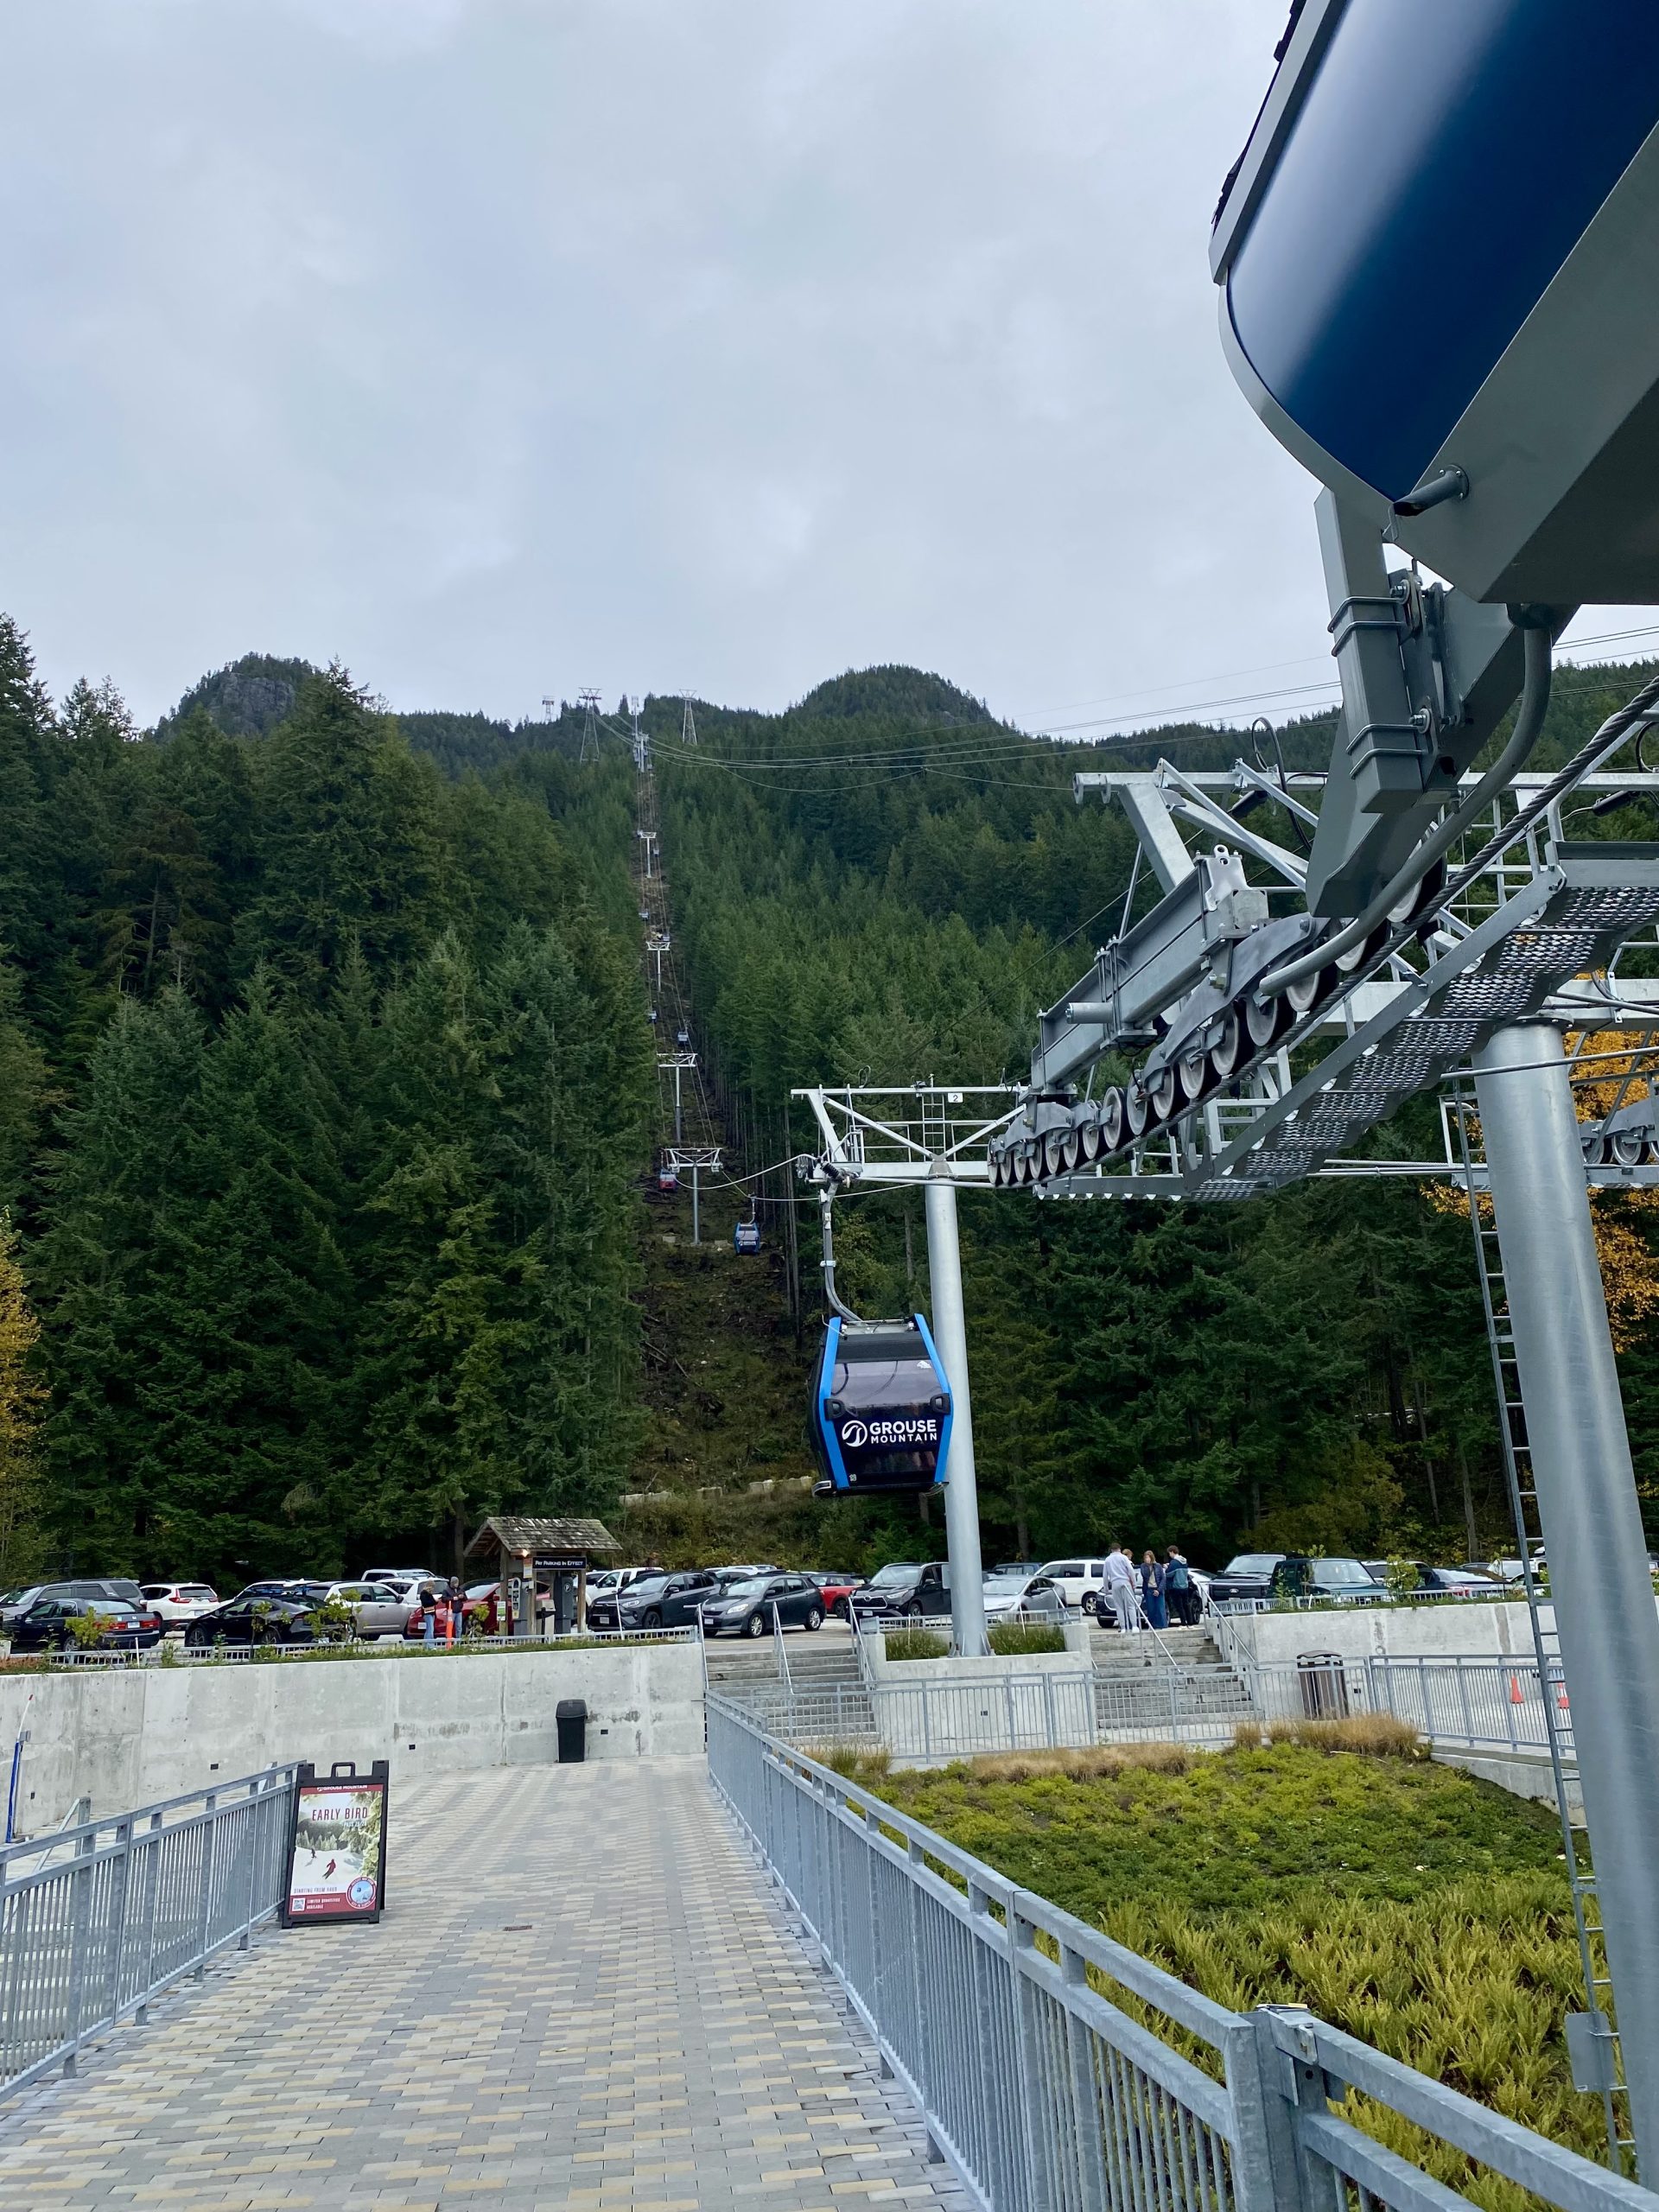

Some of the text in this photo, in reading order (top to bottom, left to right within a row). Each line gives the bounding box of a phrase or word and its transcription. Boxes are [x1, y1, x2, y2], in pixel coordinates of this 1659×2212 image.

[869, 1420, 937, 1434] GROUSE
[871, 1433, 938, 1444] MOUNTAIN
[312, 1807, 368, 1821] EARLY BIRD
